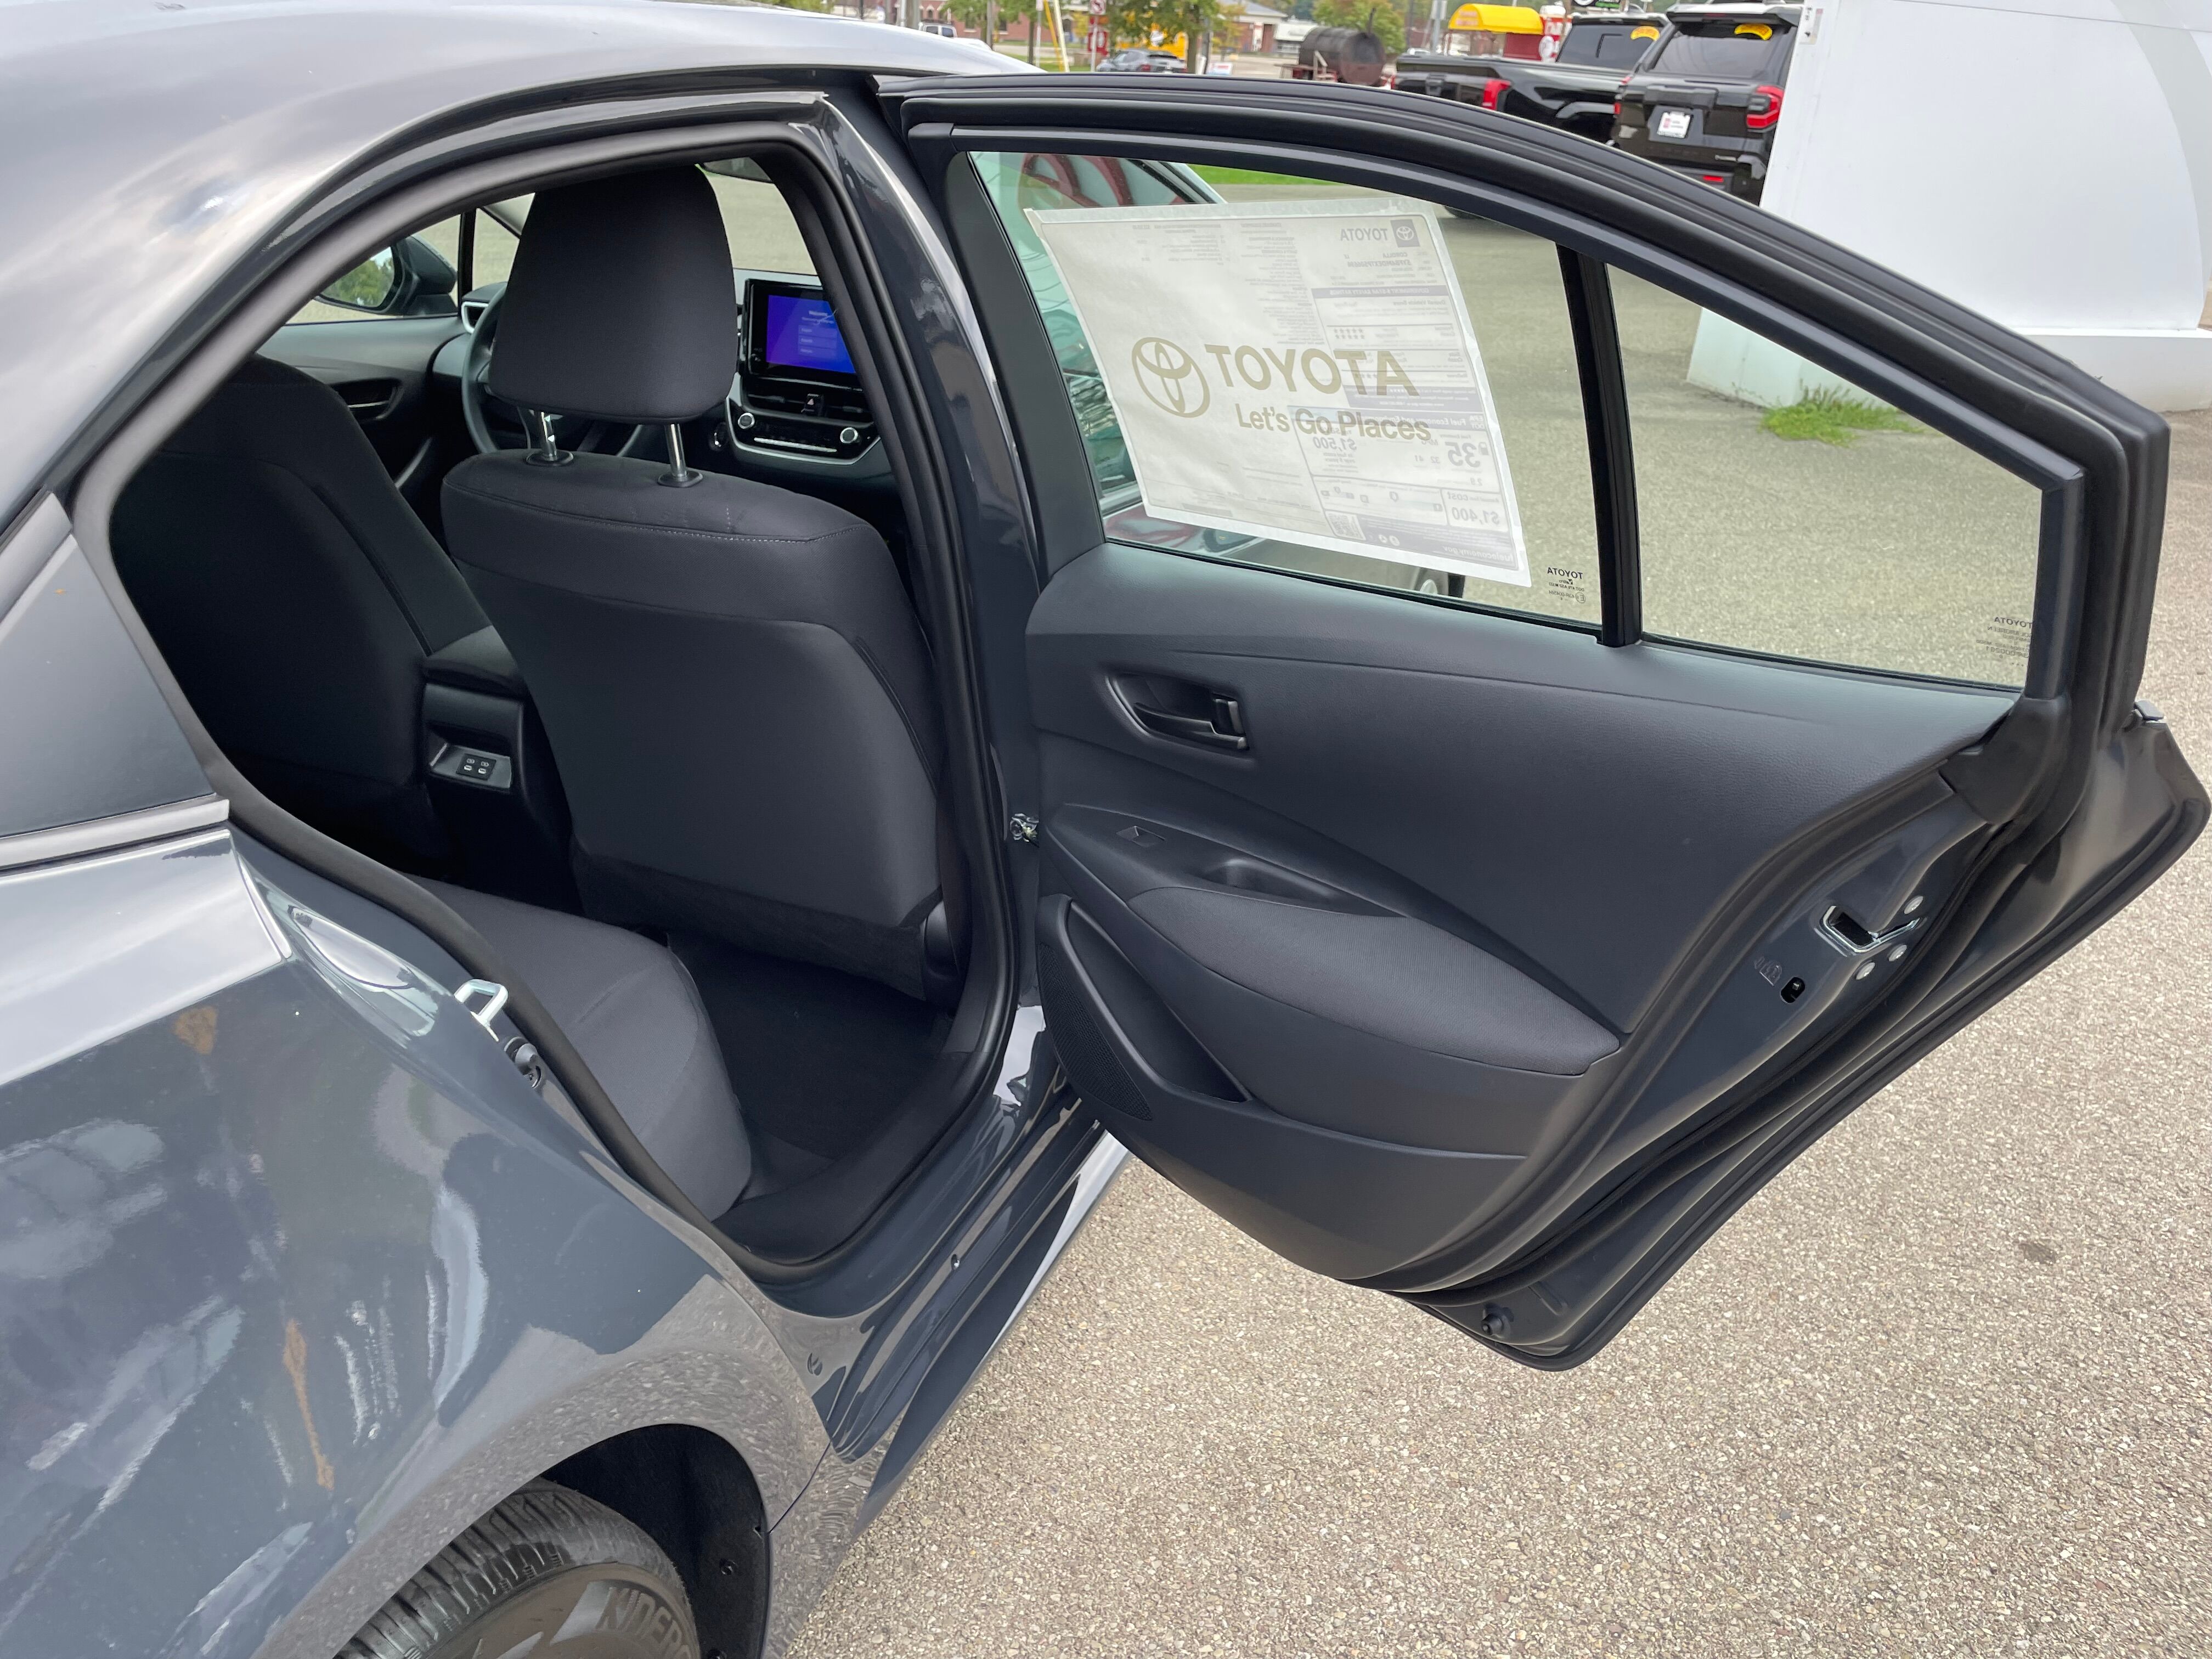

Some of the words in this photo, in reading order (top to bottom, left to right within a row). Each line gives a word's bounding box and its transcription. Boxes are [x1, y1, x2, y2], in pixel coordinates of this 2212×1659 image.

[1204, 344, 1420, 396] TOYOTA
[1235, 403, 1290, 432] Let's
[1295, 408, 1331, 435] Go
[1338, 411, 1431, 441] Places
